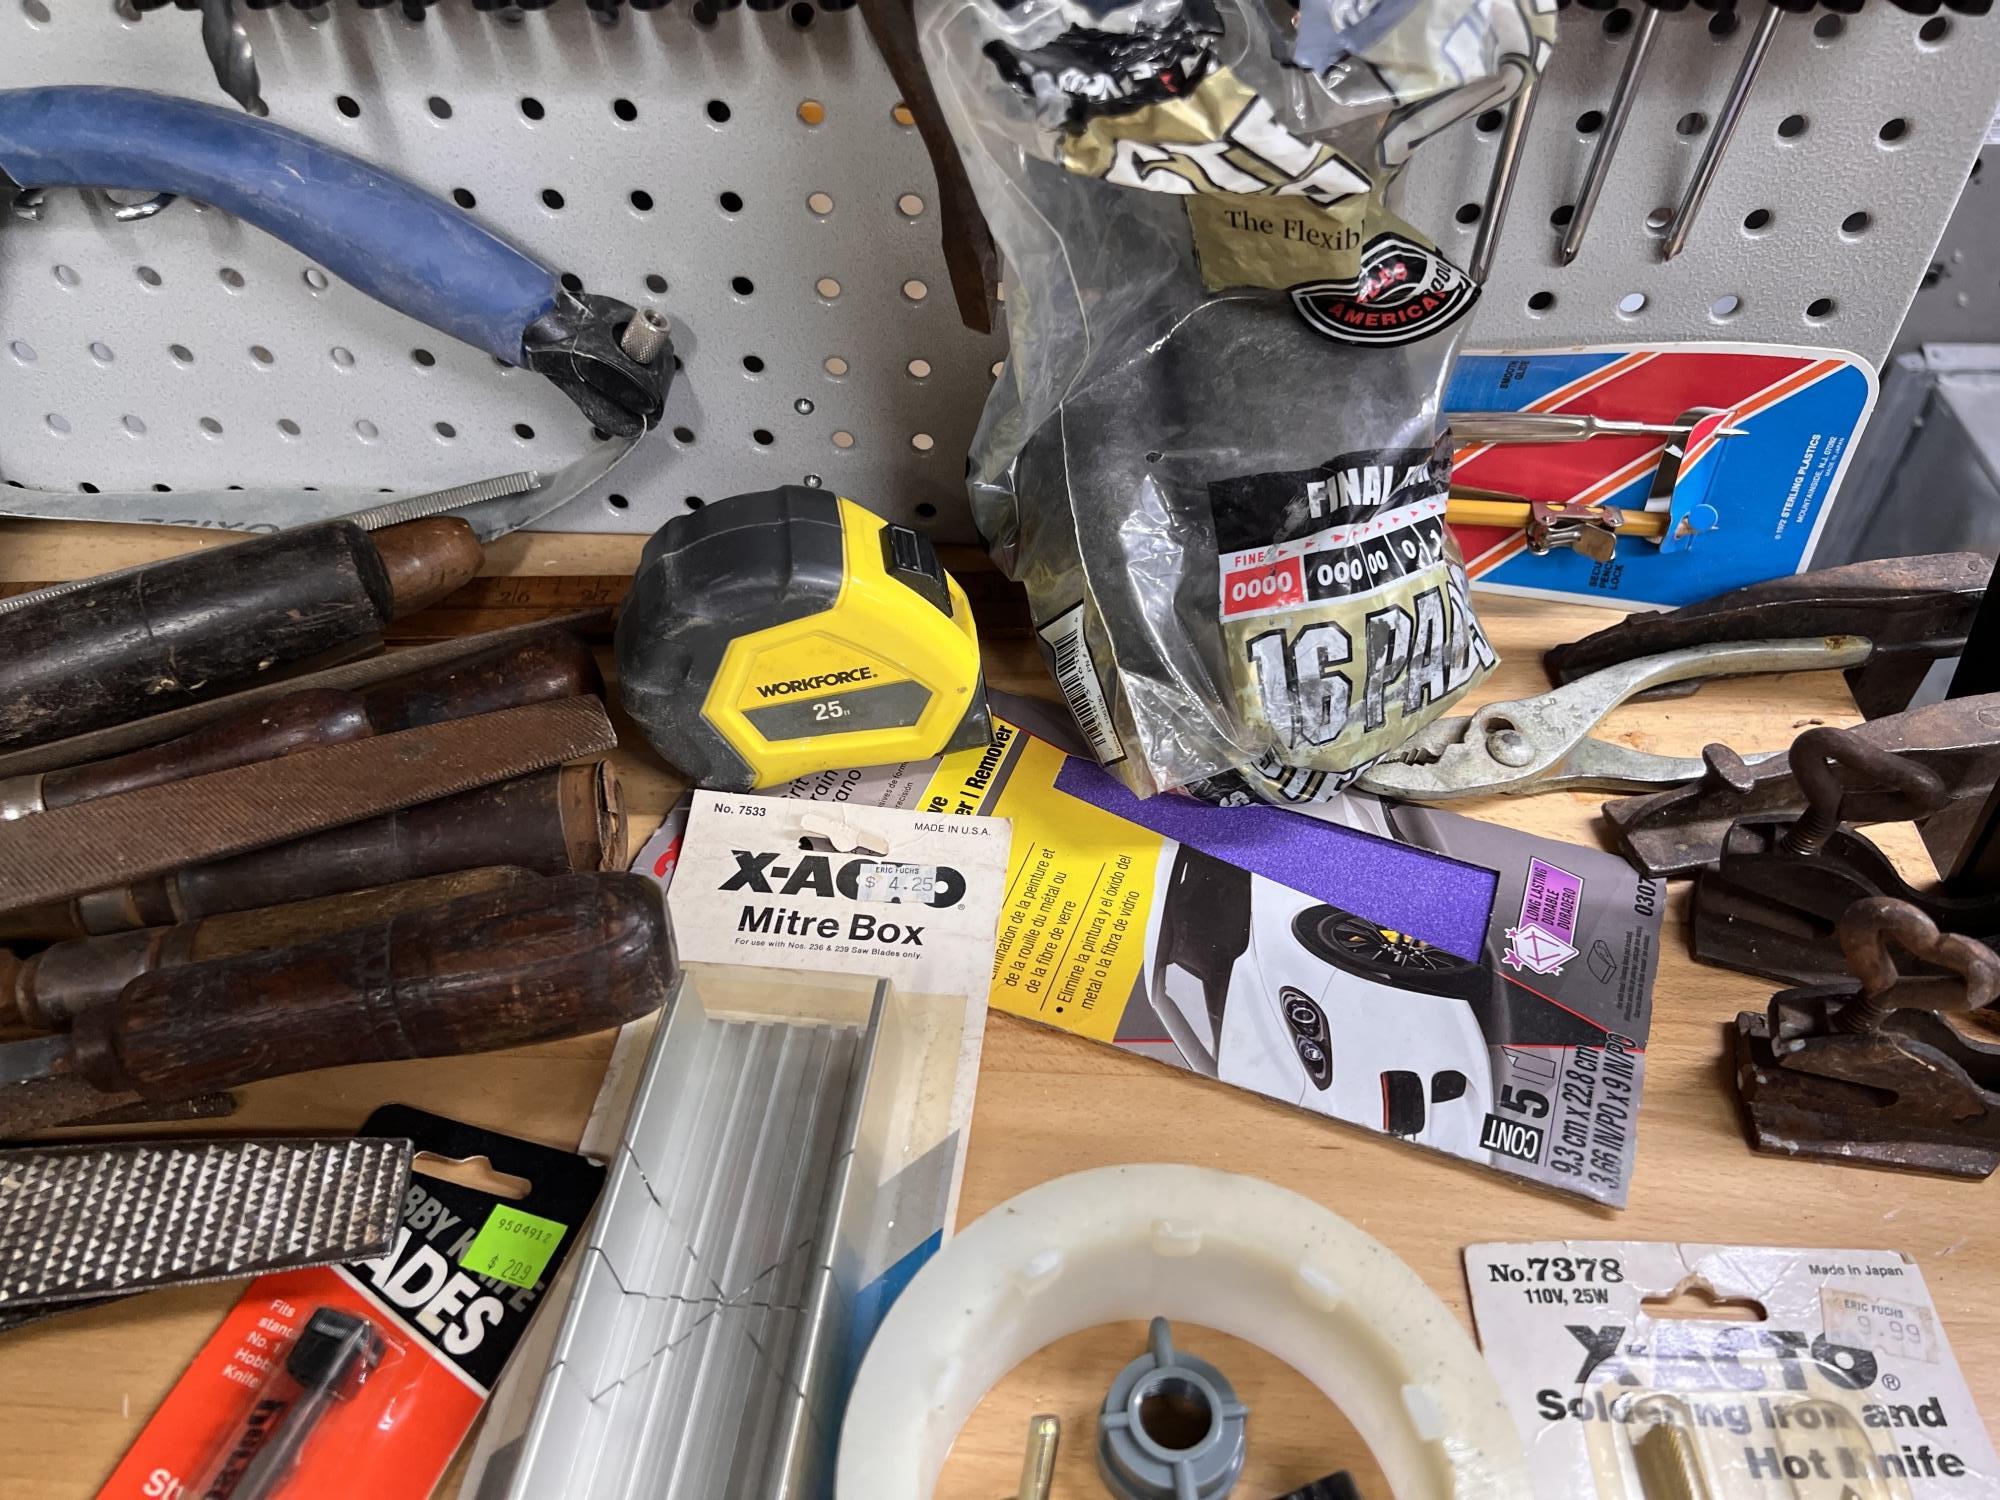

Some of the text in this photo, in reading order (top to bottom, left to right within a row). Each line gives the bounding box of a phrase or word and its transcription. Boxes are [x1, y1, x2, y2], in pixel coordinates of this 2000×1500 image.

[1225, 210, 1273, 234] The
[1781, 476, 1804, 518] STERLING
[1798, 434, 1821, 475] PLASTICS
[1306, 466, 1395, 519] FINAL
[1234, 552, 1265, 567] FINE
[1232, 571, 1294, 601] 0000
[1317, 557, 1363, 586] 000
[1368, 550, 1389, 574] 00
[1247, 621, 1354, 750] 16
[813, 700, 843, 721] 25
[810, 769, 839, 801] rain
[888, 778, 898, 789] de
[955, 724, 1013, 815] er Remover
[832, 769, 862, 802] ano
[896, 782, 914, 809] recisión
[713, 803, 767, 818] No. 7533
[927, 796, 948, 812] ve
[914, 821, 992, 837] MADE IN U.S.A.
[1042, 848, 1056, 860] et
[718, 849, 967, 909] X-ACO
[865, 875, 934, 891] $ 4.25
[895, 867, 920, 875] FUCHS
[1023, 860, 1050, 901] peinture
[1016, 899, 1030, 910] la
[1526, 867, 1548, 922] LONG LASTING
[1541, 889, 1560, 926] DURABLE
[1557, 887, 1577, 931] DURADERO
[738, 906, 926, 946] Mitre Box
[1004, 872, 1067, 987] de la rouille du métal ou
[1012, 910, 1025, 924] de
[1057, 854, 1133, 1004] Elimine la pintura y el óxido del
[734, 938, 749, 946] For
[788, 942, 806, 951] Nos.
[809, 943, 824, 951] 236
[834, 945, 849, 953] 239
[852, 946, 869, 954] Saw
[871, 948, 900, 957] Blades
[902, 950, 924, 960] only.
[1026, 900, 1077, 994] de la fibre de verre
[1081, 891, 1140, 1010] metal o la fibra de vidrio
[1601, 1075, 1632, 1094] 9
[1484, 1084, 1550, 1160] CONT 5
[1550, 1044, 1600, 1177] 9.3 cm x 22.8 cm
[401, 1184, 462, 1241] BBY
[1808, 1264, 1845, 1276] Made
[1865, 1265, 1904, 1278] Japan
[352, 1226, 505, 1356] ADES
[1524, 1288, 1609, 1306] 110V, 25W
[270, 1299, 296, 1318] Fits
[1844, 1299, 1904, 1319] ERIC FUCHS
[246, 1331, 268, 1350] No.
[1858, 1315, 1921, 1344] 9.99
[1862, 1397, 1948, 1428] and
[1745, 1447, 1831, 1480] Hot
